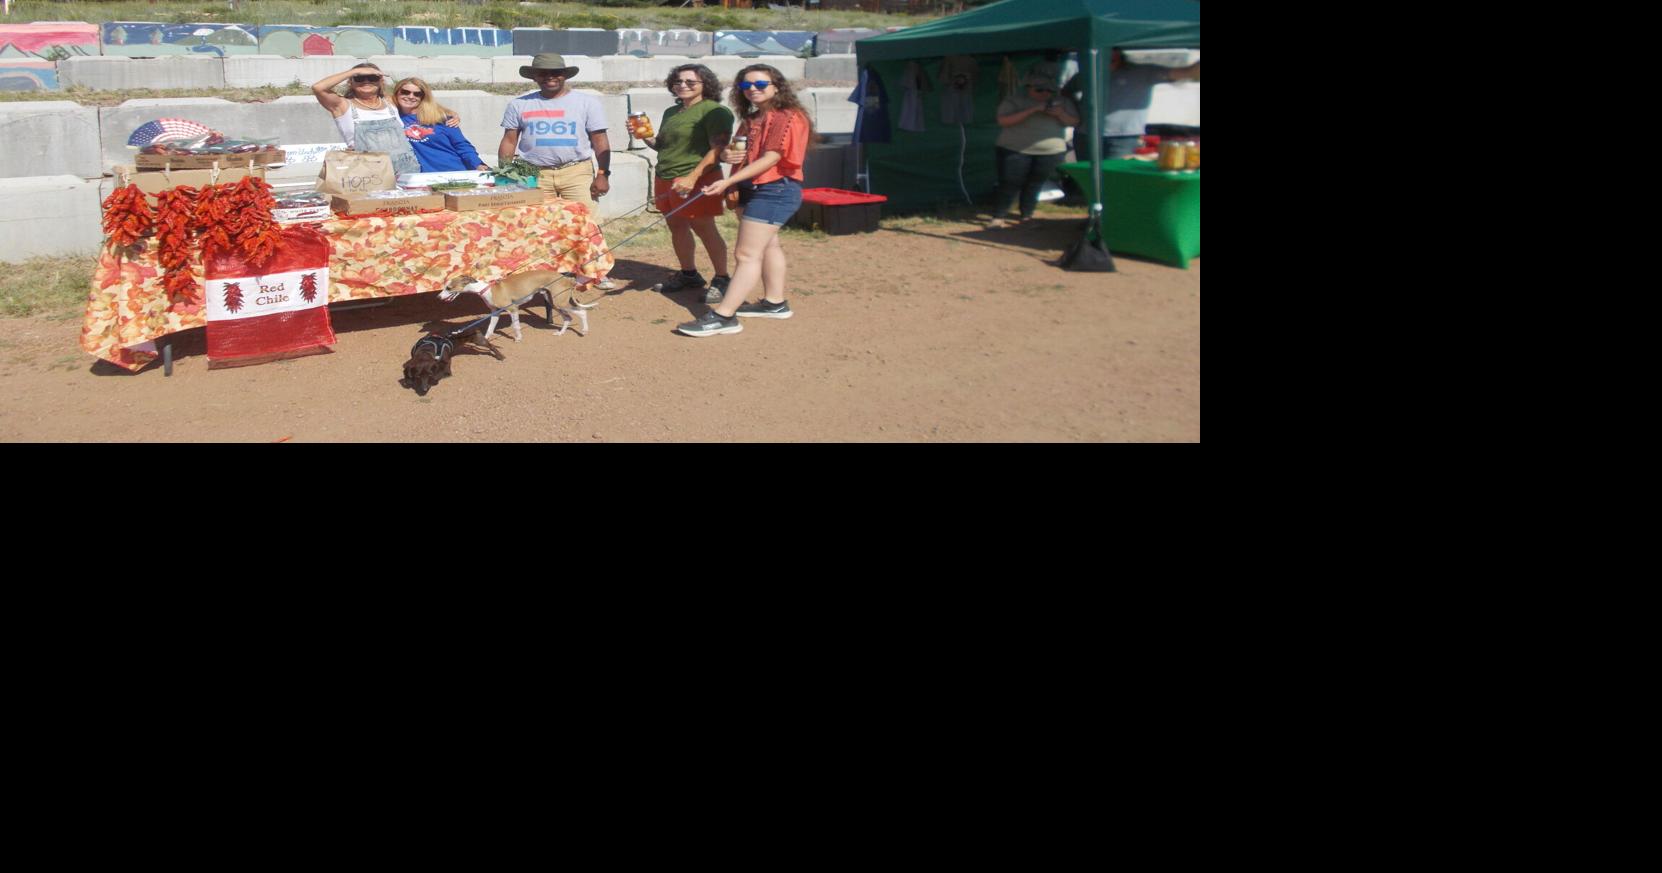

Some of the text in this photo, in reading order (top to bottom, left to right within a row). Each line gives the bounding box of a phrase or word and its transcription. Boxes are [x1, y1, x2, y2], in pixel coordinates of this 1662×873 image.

[527, 121, 577, 136] 1961
[341, 174, 384, 190] HOPS
[259, 283, 286, 294] Red
[255, 294, 290, 306] Chile
